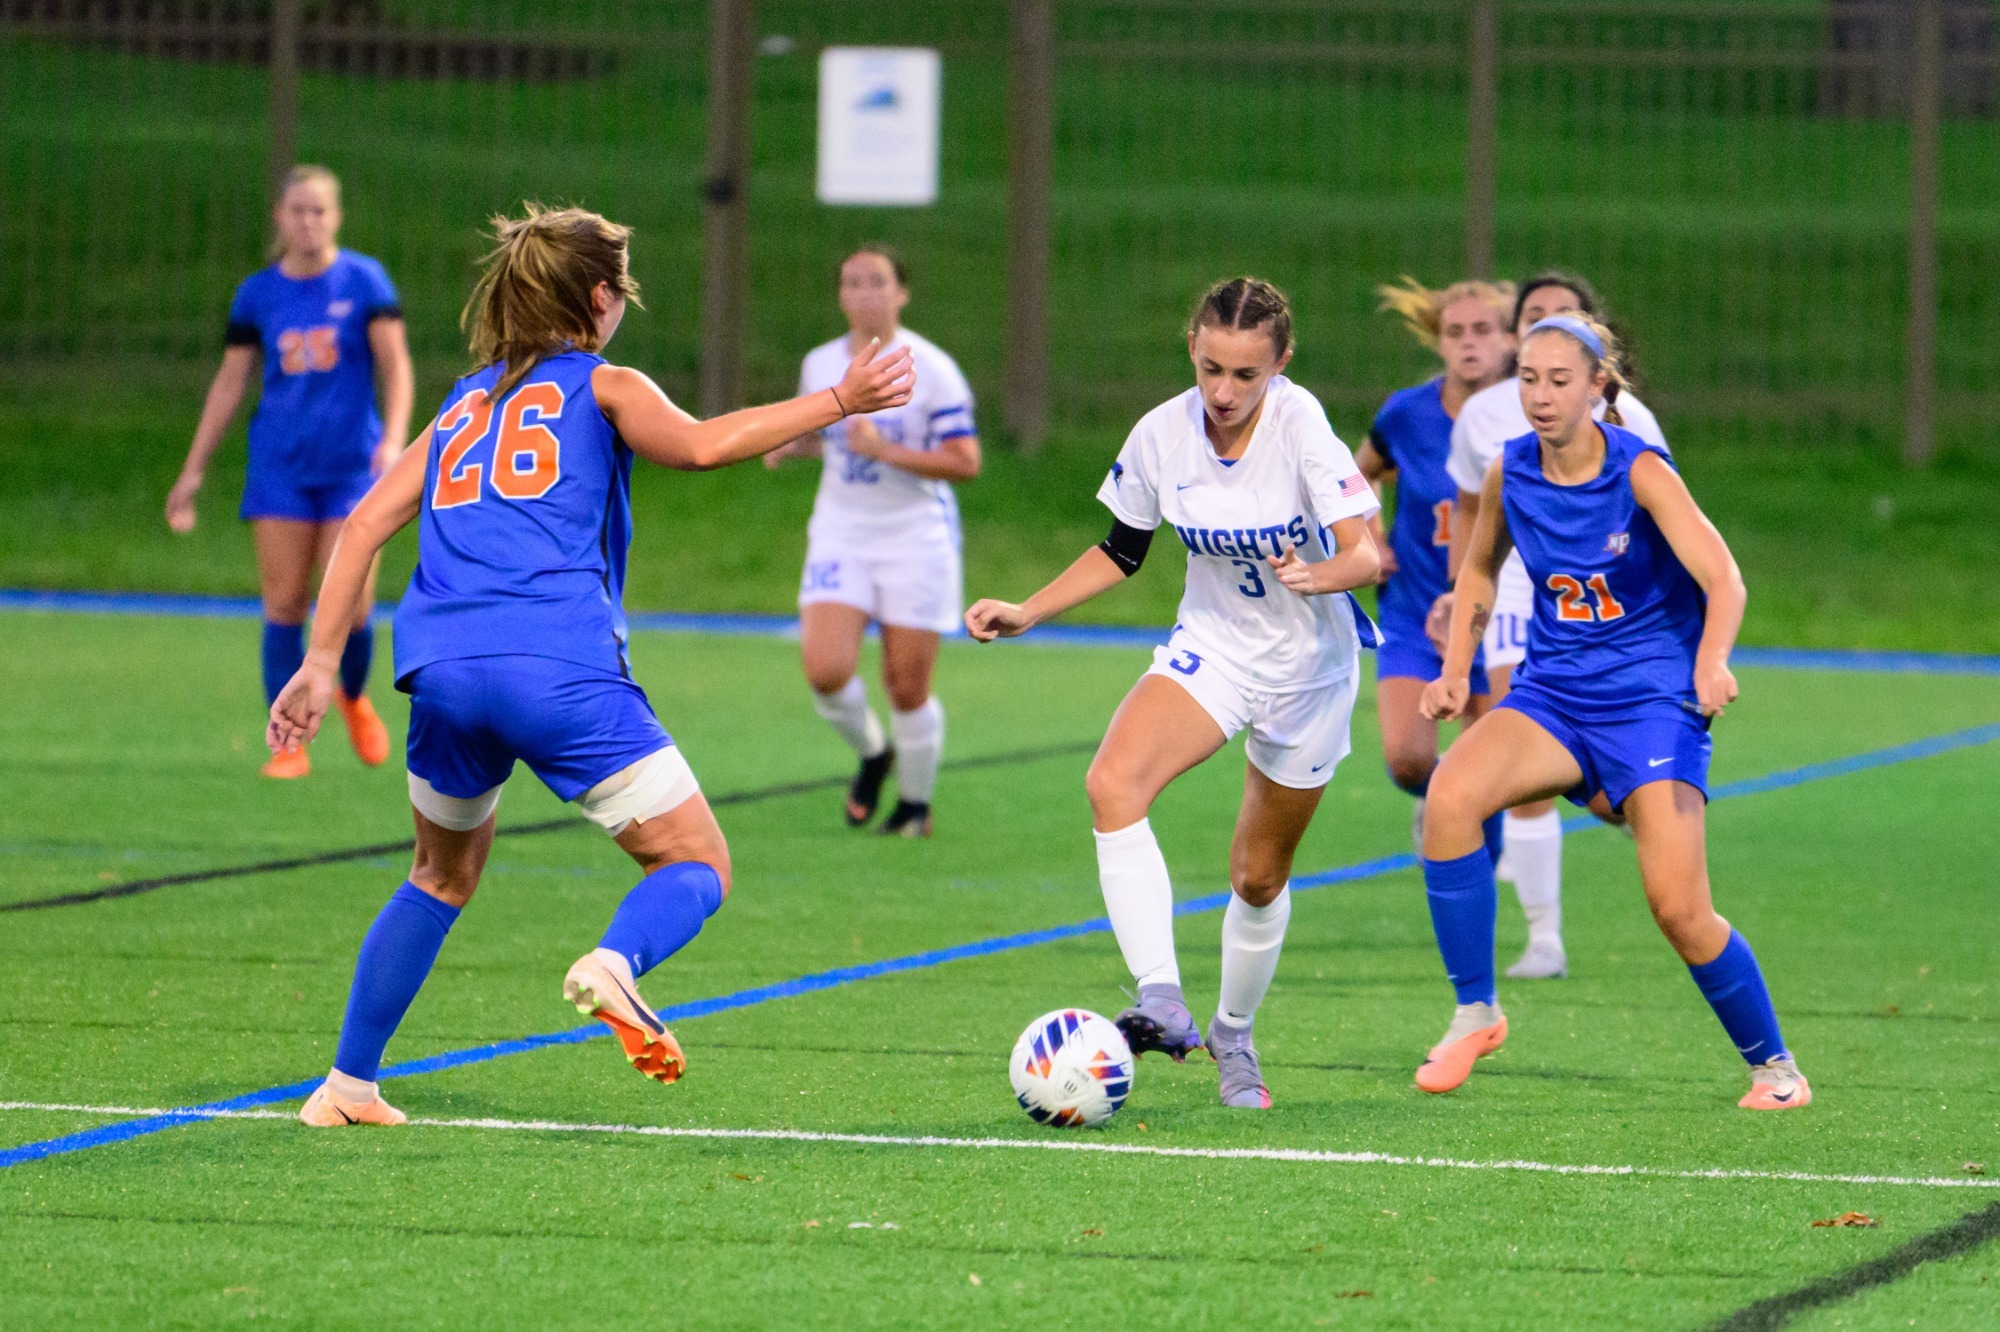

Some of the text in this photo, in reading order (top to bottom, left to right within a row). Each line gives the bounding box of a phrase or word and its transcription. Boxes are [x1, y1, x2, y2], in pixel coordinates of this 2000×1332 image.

[431, 381, 566, 511] 26
[1231, 559, 1267, 598] 3
[1545, 573, 1626, 622] 21
[1169, 650, 1202, 676] 3
